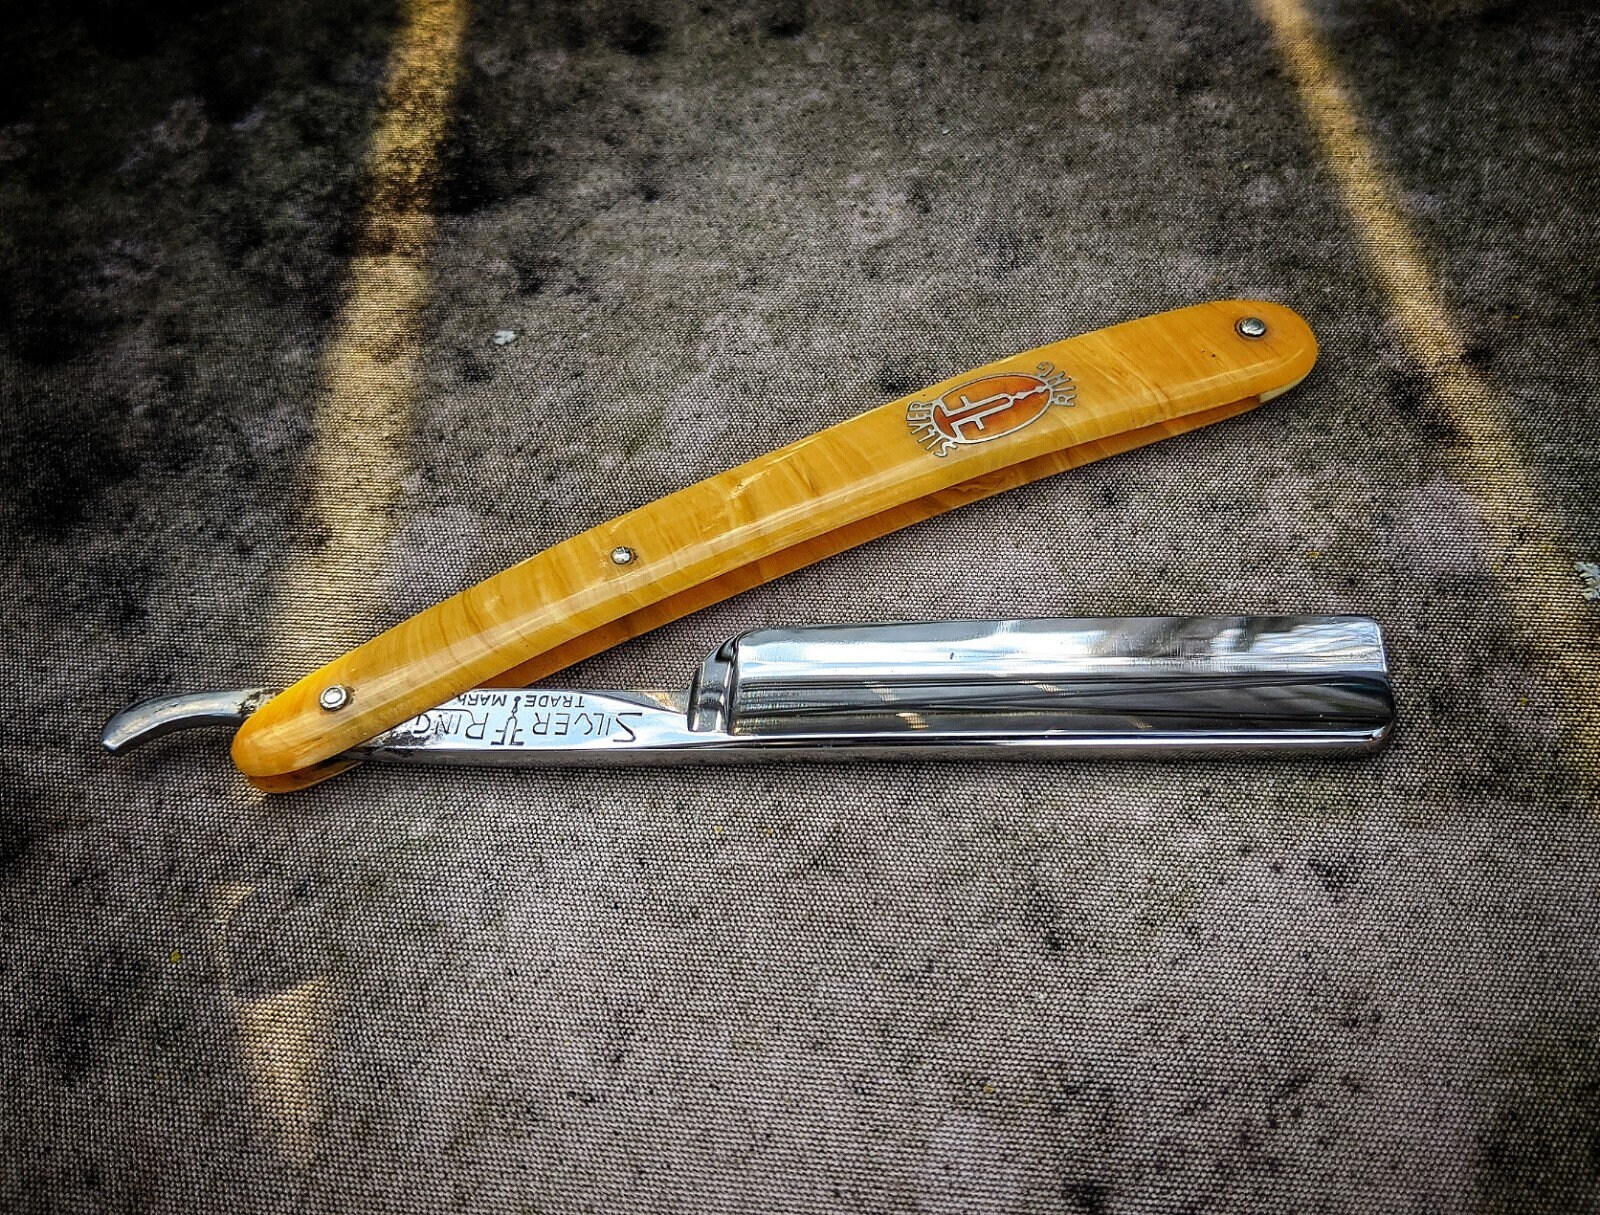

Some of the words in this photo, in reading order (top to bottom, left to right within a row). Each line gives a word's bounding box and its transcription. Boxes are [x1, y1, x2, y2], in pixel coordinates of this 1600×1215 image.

[907, 402, 957, 458] SILVER
[1036, 362, 1077, 407] RING
[525, 694, 585, 707] TRADE
[413, 709, 489, 740] RING
[532, 712, 642, 743] SILVER
